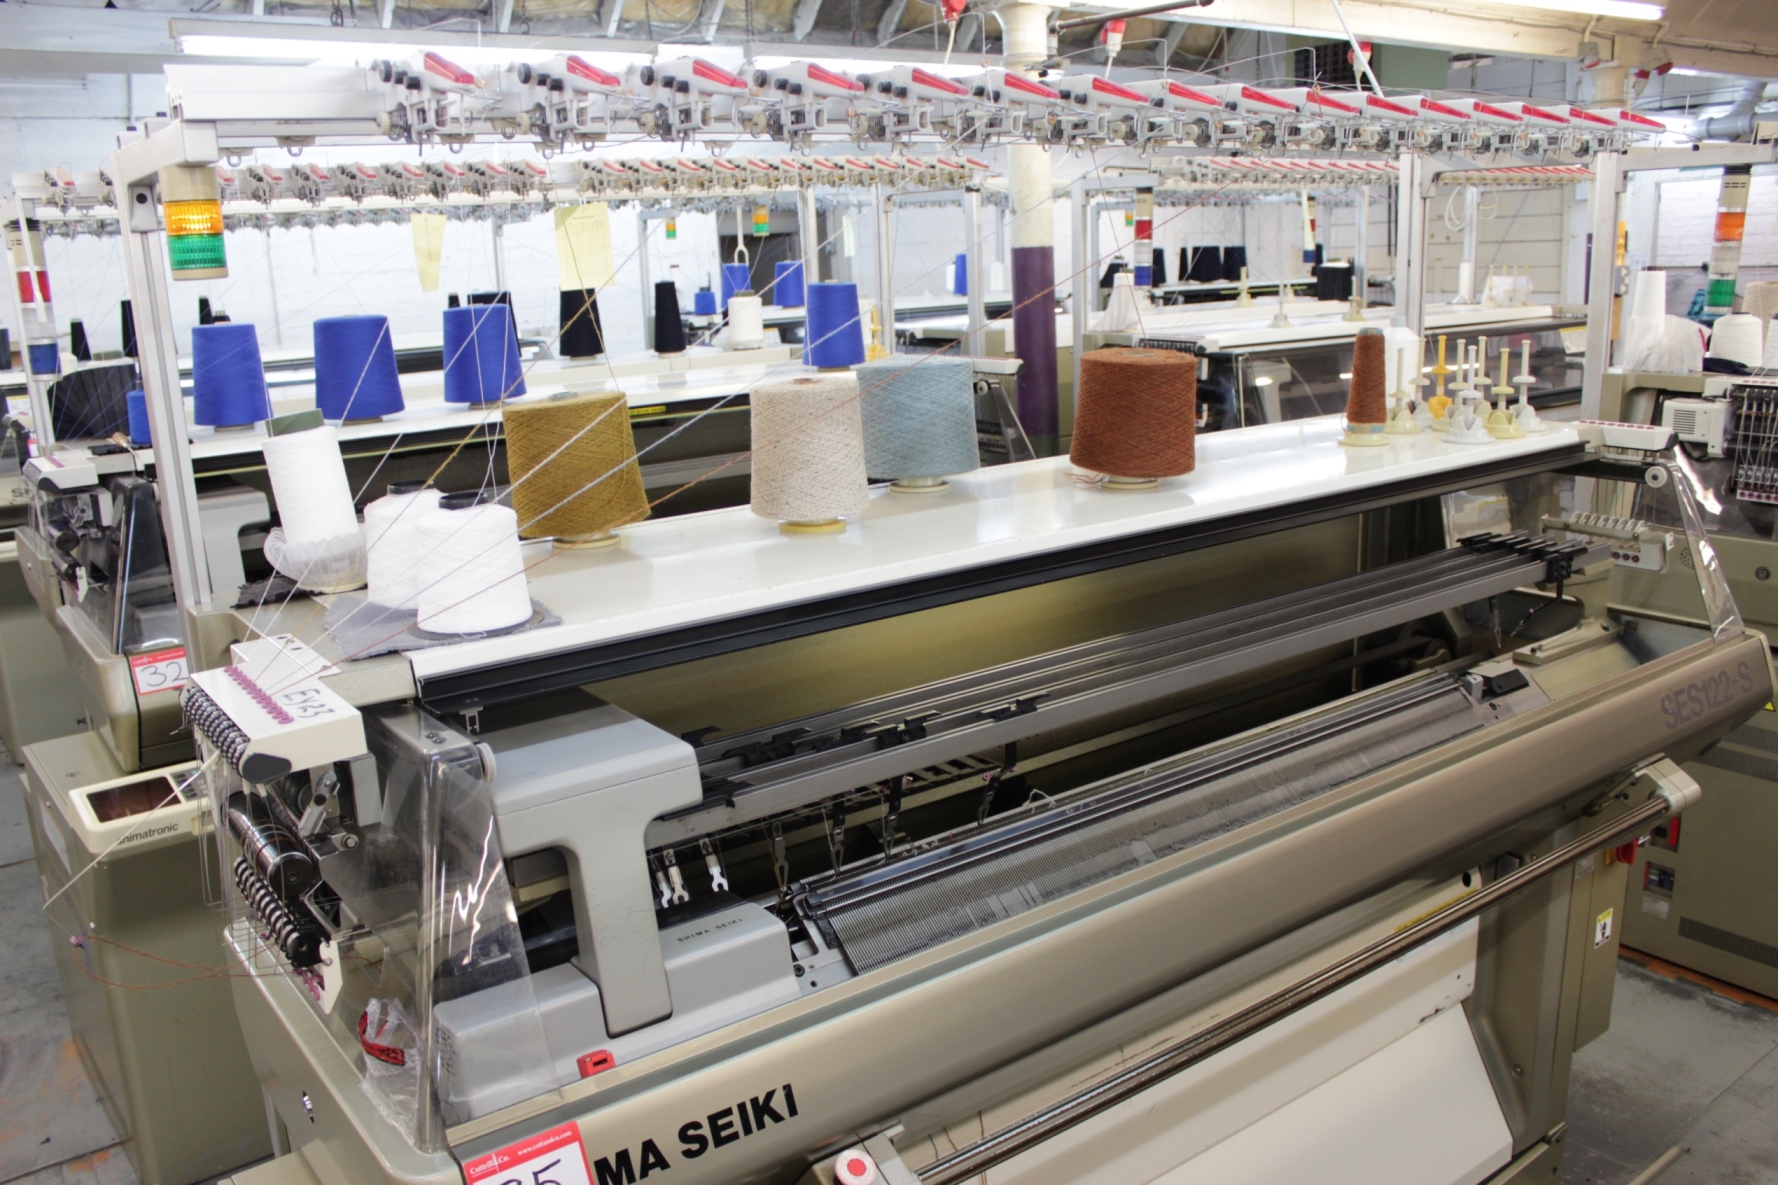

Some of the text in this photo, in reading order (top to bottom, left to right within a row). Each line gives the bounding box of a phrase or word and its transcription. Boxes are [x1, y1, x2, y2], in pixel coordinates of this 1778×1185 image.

[140, 661, 189, 687] 32
[1660, 660, 1754, 730] SES122-S
[677, 918, 743, 942] SHIMA SEIKI
[677, 1083, 799, 1159] SEIKI
